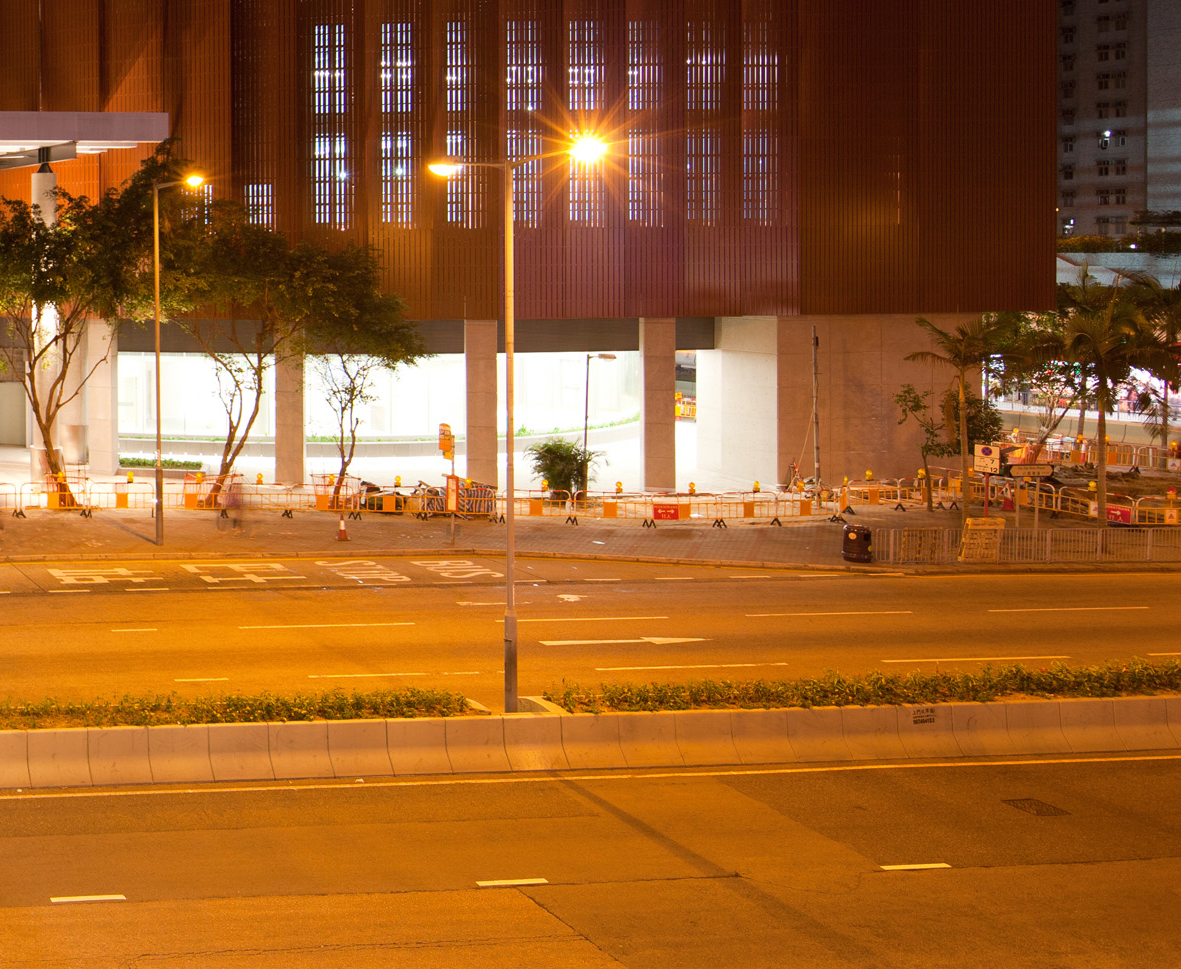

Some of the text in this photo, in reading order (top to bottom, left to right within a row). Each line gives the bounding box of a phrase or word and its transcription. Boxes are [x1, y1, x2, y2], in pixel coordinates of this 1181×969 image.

[46, 567, 164, 584] 站
[179, 563, 307, 583] 巴士
[314, 560, 412, 582] STOP
[410, 560, 505, 578] BUS
